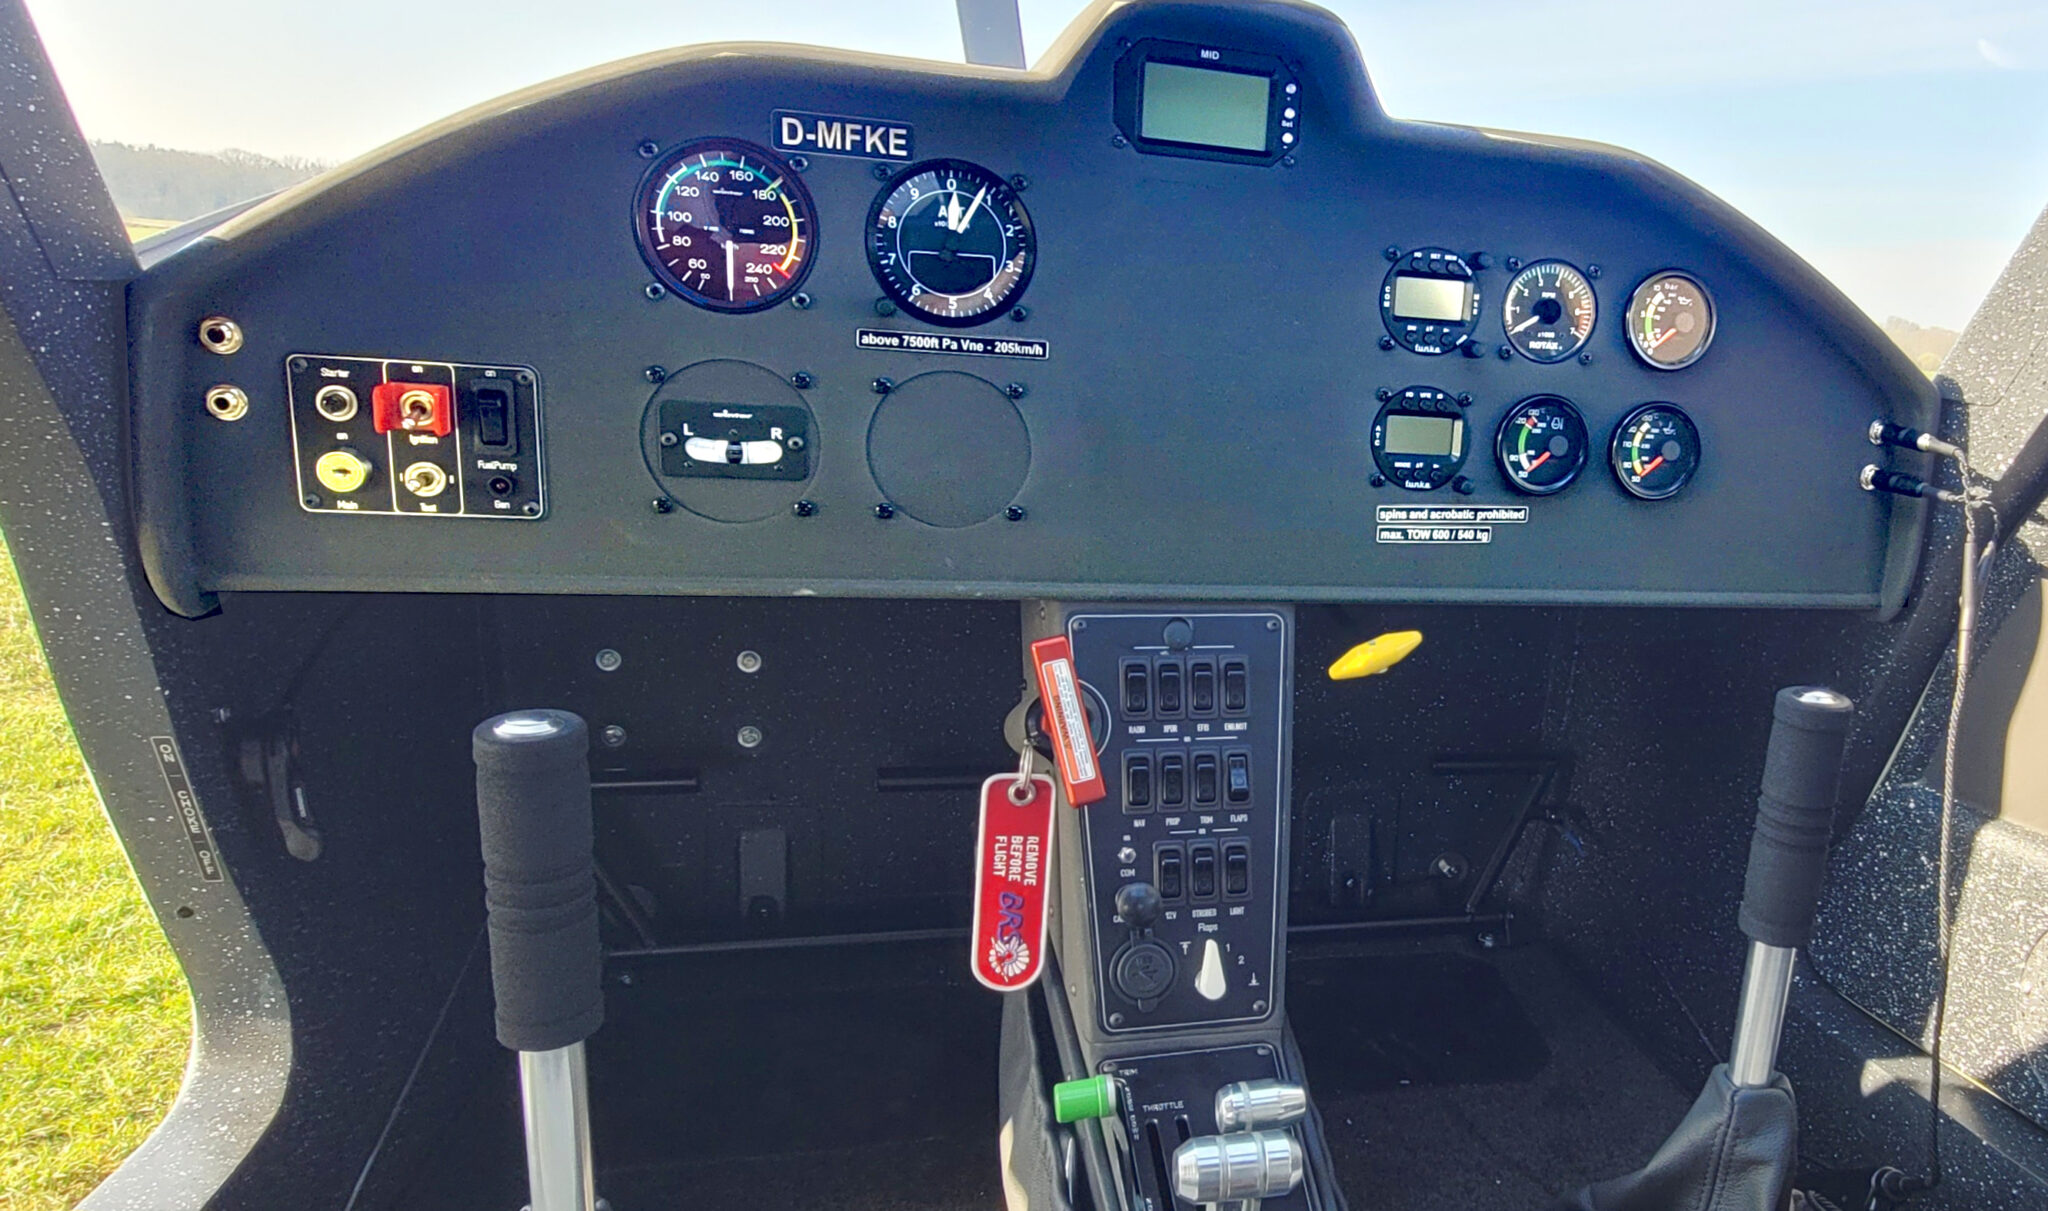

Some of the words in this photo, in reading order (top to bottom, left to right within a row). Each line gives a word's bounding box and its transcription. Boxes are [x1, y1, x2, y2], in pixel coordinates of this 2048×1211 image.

[1201, 49, 1220, 60] MID
[782, 117, 907, 156] D-MFKE
[695, 170, 719, 182] 140
[729, 169, 754, 182] 160
[674, 185, 700, 197] 120
[946, 178, 957, 191] 0
[752, 189, 777, 201] 180
[910, 187, 920, 201] 9
[986, 195, 992, 207] 1
[667, 210, 692, 223] 100
[937, 204, 966, 219] AT
[763, 215, 790, 227] 200
[887, 216, 897, 229] 8
[1005, 225, 1015, 237] 2
[672, 236, 691, 247] 80
[760, 244, 787, 255] 220
[688, 258, 707, 270] 60
[888, 253, 897, 266] 7
[746, 263, 772, 274] 240
[1005, 260, 1014, 273] 3
[911, 284, 920, 296] 6
[948, 297, 958, 310] 5
[861, 333, 900, 347] above
[901, 335, 940, 349] 7500ft
[942, 337, 958, 350] Pa
[960, 339, 984, 352] Vne
[994, 341, 1043, 356] 205km/h
[320, 367, 350, 378] Starter
[683, 423, 694, 436] L
[770, 427, 783, 440] R
[336, 500, 359, 510] Main
[1379, 508, 1408, 522] spins
[1408, 508, 1429, 520] and
[1429, 509, 1475, 520] acrobatic
[1476, 509, 1525, 523] prohibited
[1380, 531, 1405, 540] max.
[1406, 529, 1430, 540] TOW
[1432, 529, 1449, 540] 600
[1457, 529, 1475, 540] 540
[1475, 529, 1489, 542] kg
[159, 743, 175, 763] ON
[177, 790, 201, 834] CHOKE
[1229, 814, 1248, 823] FLAPS
[200, 850, 215, 875] OFF
[992, 835, 1008, 878] FLIGHT
[1008, 835, 1024, 883] BEFORE
[1023, 836, 1040, 887] REMOVE
[1120, 869, 1136, 877] COM
[1226, 943, 1231, 953] 1
[1238, 956, 1245, 965] 2
[1142, 1100, 1185, 1112] THROTTLE
